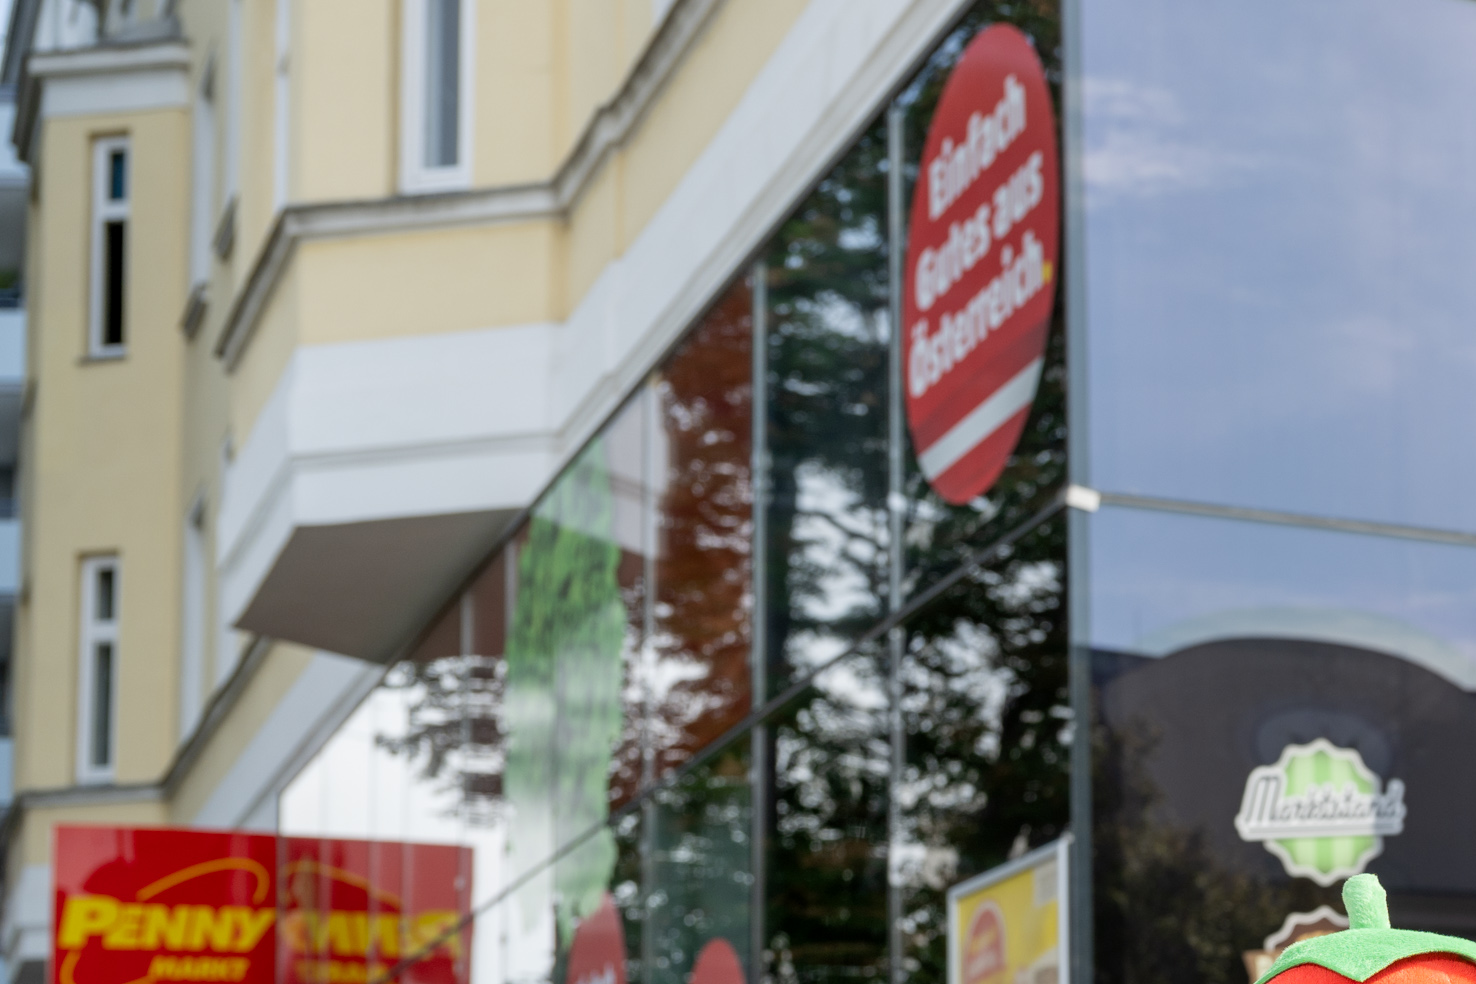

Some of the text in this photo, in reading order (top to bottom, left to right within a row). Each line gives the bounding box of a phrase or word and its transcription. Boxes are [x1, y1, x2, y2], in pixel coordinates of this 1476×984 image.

[929, 74, 1025, 220] Einfach
[915, 150, 1044, 311] Gutes aus
[57, 895, 277, 951] PENNY
[148, 955, 251, 982] MARKT
